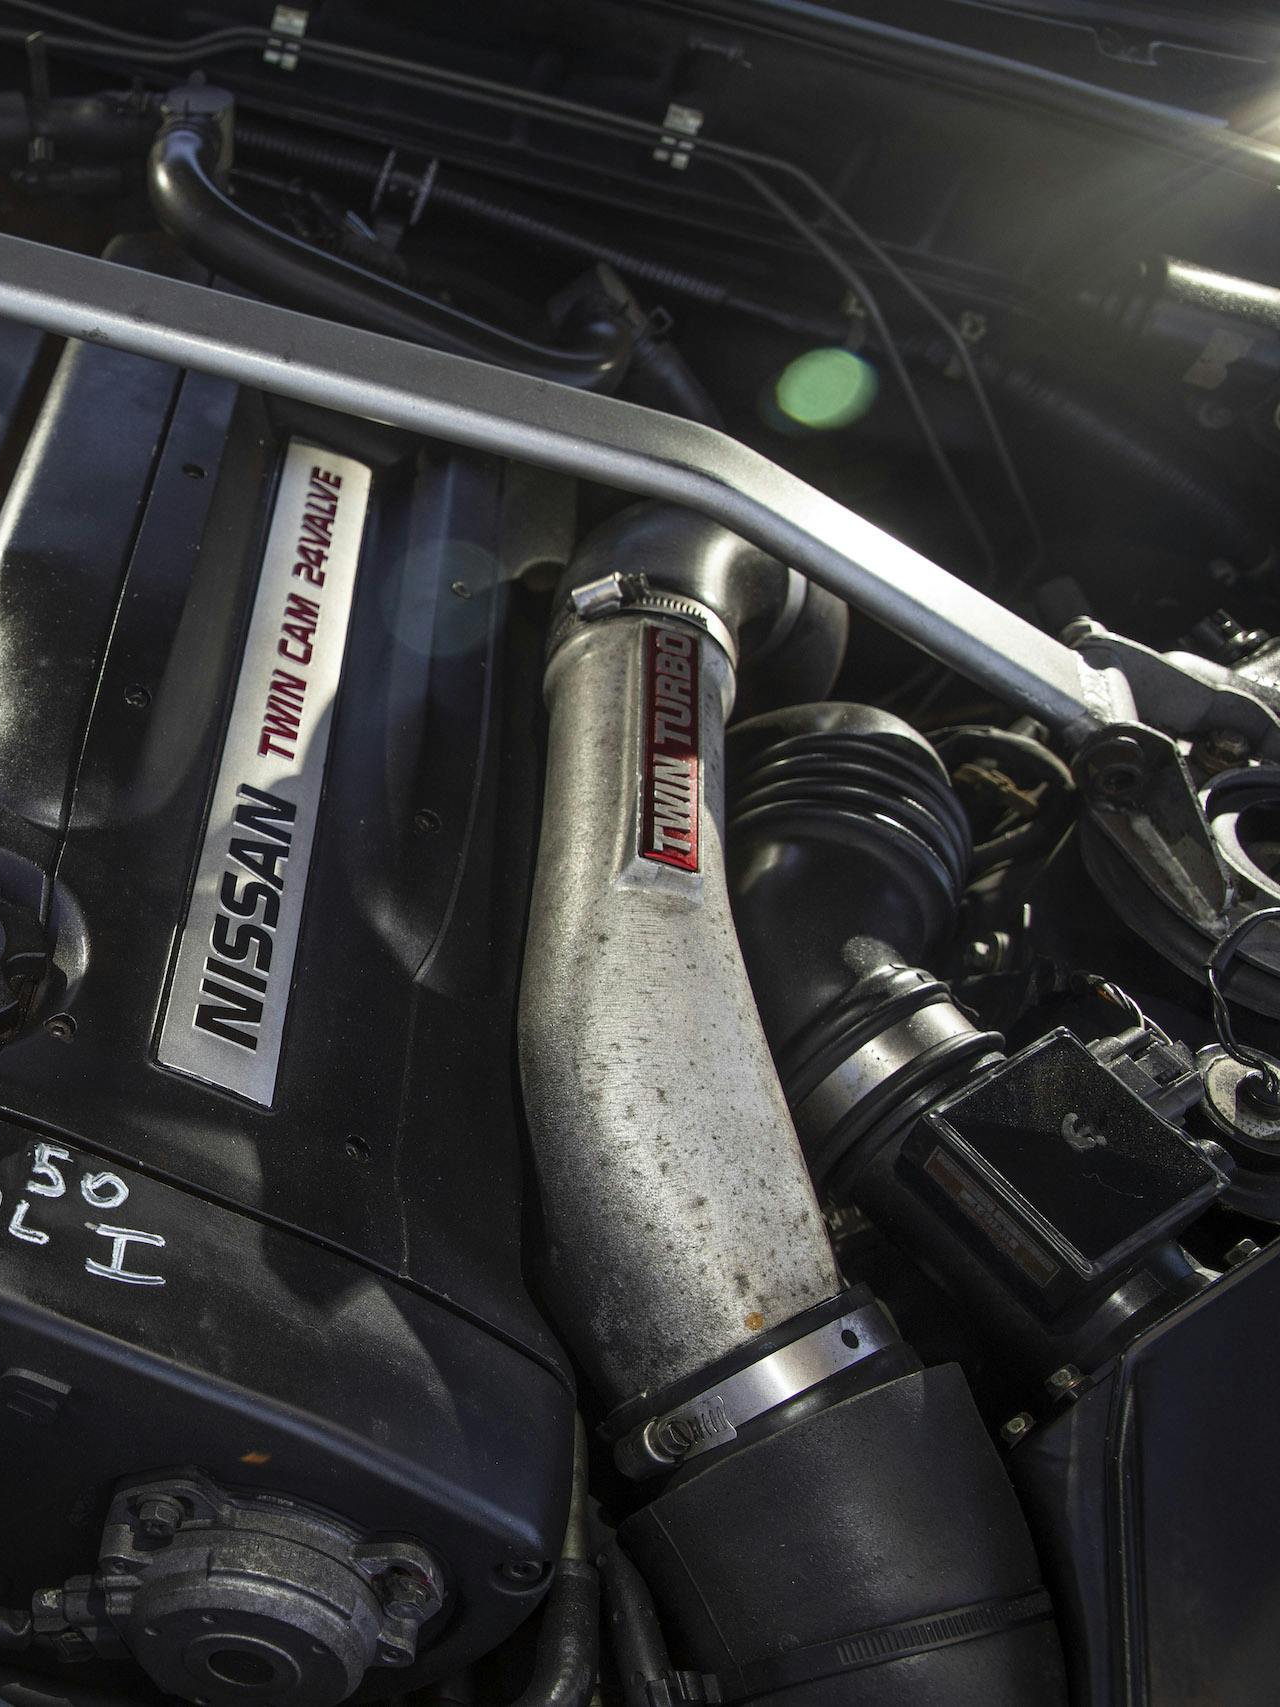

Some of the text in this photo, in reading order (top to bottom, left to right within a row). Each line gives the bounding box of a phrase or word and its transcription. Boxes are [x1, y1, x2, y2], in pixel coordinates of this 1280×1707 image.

[191, 466, 344, 1054] NISSAN TWIN CAM 24VALVE
[652, 629, 693, 855] TWIN TURBO
[26, 1141, 131, 1209] 50
